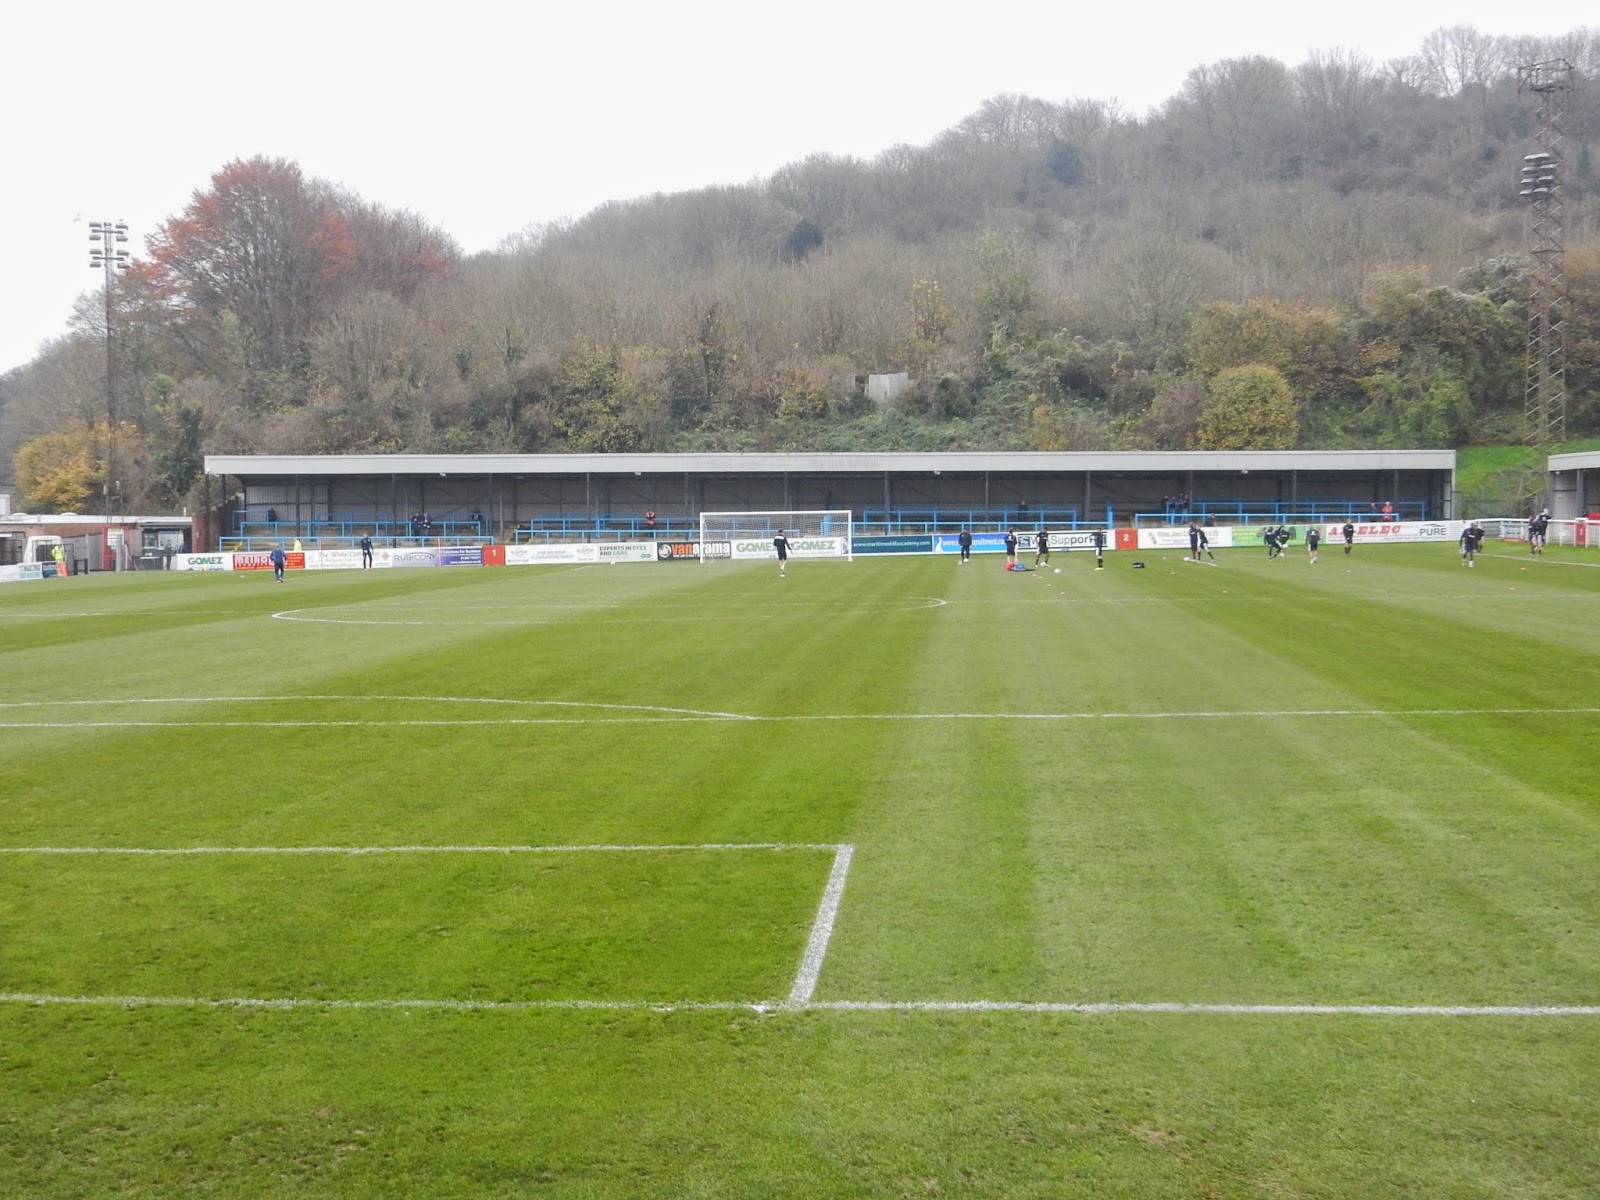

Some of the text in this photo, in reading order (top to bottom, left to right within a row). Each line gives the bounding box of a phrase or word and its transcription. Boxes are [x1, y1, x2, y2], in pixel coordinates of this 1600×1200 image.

[1420, 527, 1447, 536] PURE
[736, 542, 777, 552] GOME
[791, 540, 836, 550] GOMEZ
